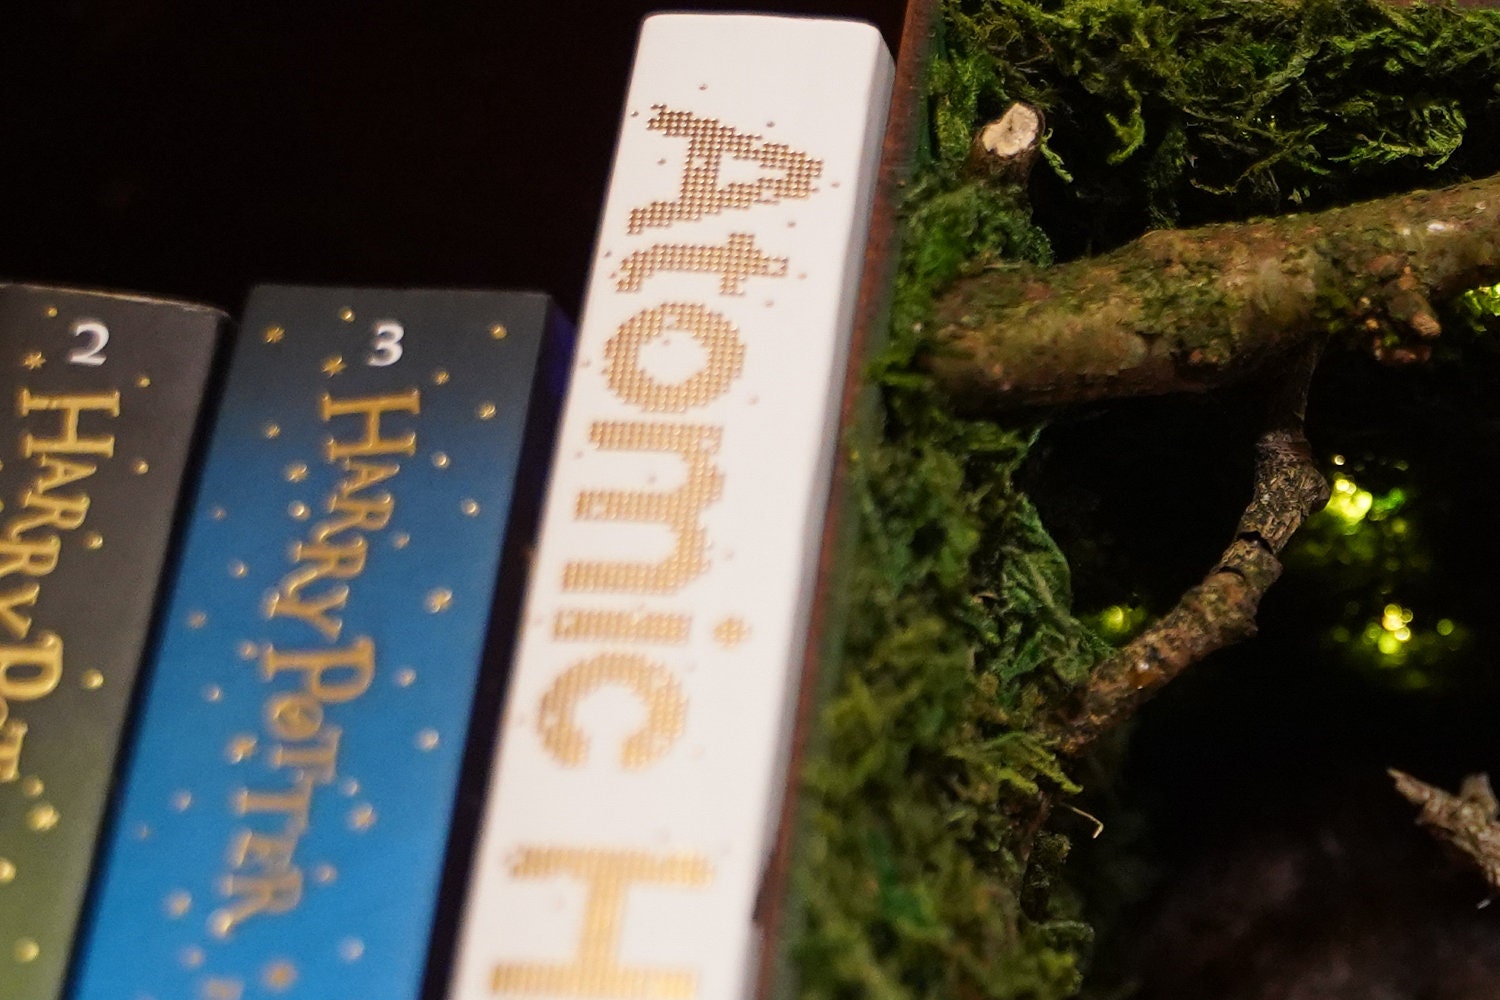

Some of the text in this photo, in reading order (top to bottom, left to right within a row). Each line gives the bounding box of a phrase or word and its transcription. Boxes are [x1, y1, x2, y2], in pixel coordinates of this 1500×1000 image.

[68, 322, 111, 366] 2
[367, 323, 405, 367] 3
[535, 102, 824, 772] Atomic
[264, 388, 421, 642] HARRY
